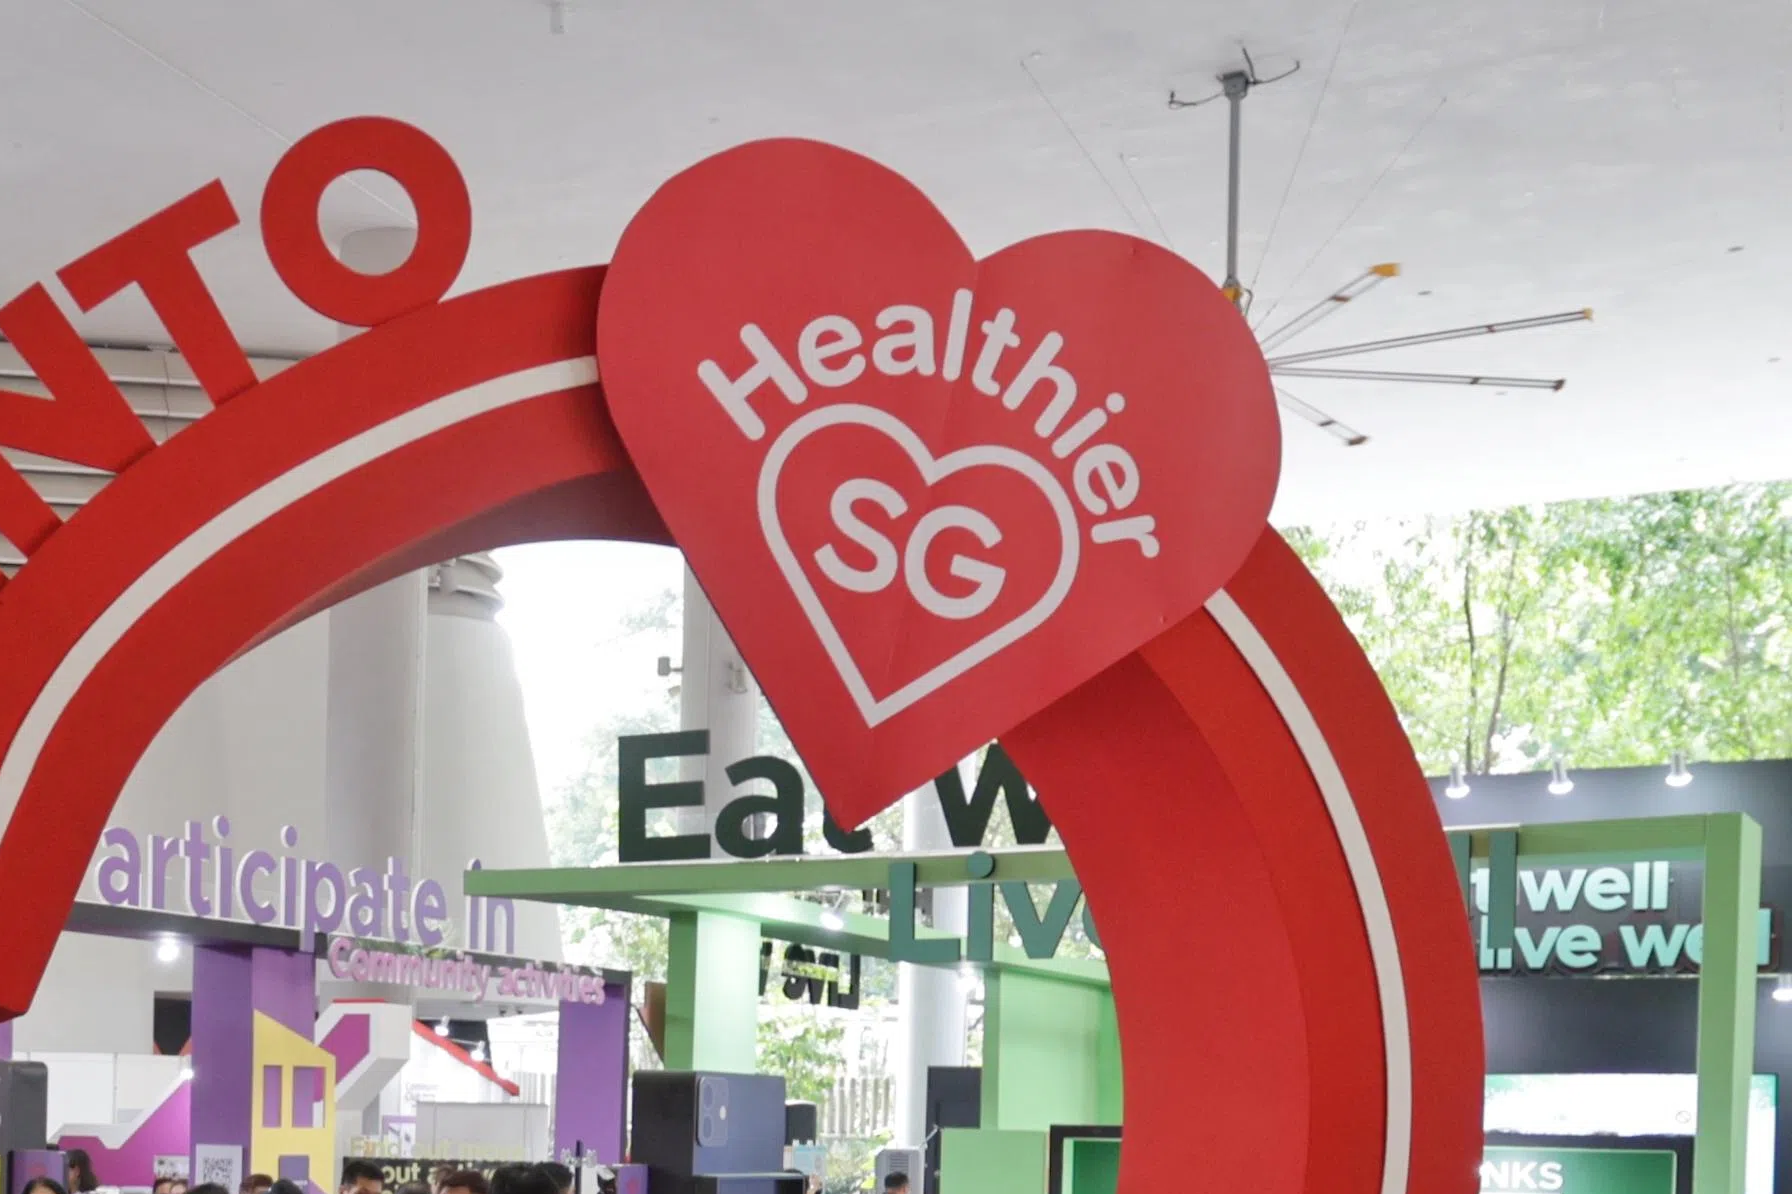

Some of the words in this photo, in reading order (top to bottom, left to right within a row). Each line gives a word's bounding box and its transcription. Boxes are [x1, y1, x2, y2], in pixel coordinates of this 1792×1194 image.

[697, 288, 1160, 559] Healthier
[814, 478, 1006, 619] SG
[94, 815, 447, 953] articipate
[465, 858, 516, 954] in
[888, 851, 1101, 962] Liv
[1520, 861, 1669, 912] well
[1619, 908, 1771, 967] wl
[327, 937, 491, 1004] Community
[496, 959, 605, 1005] activities
